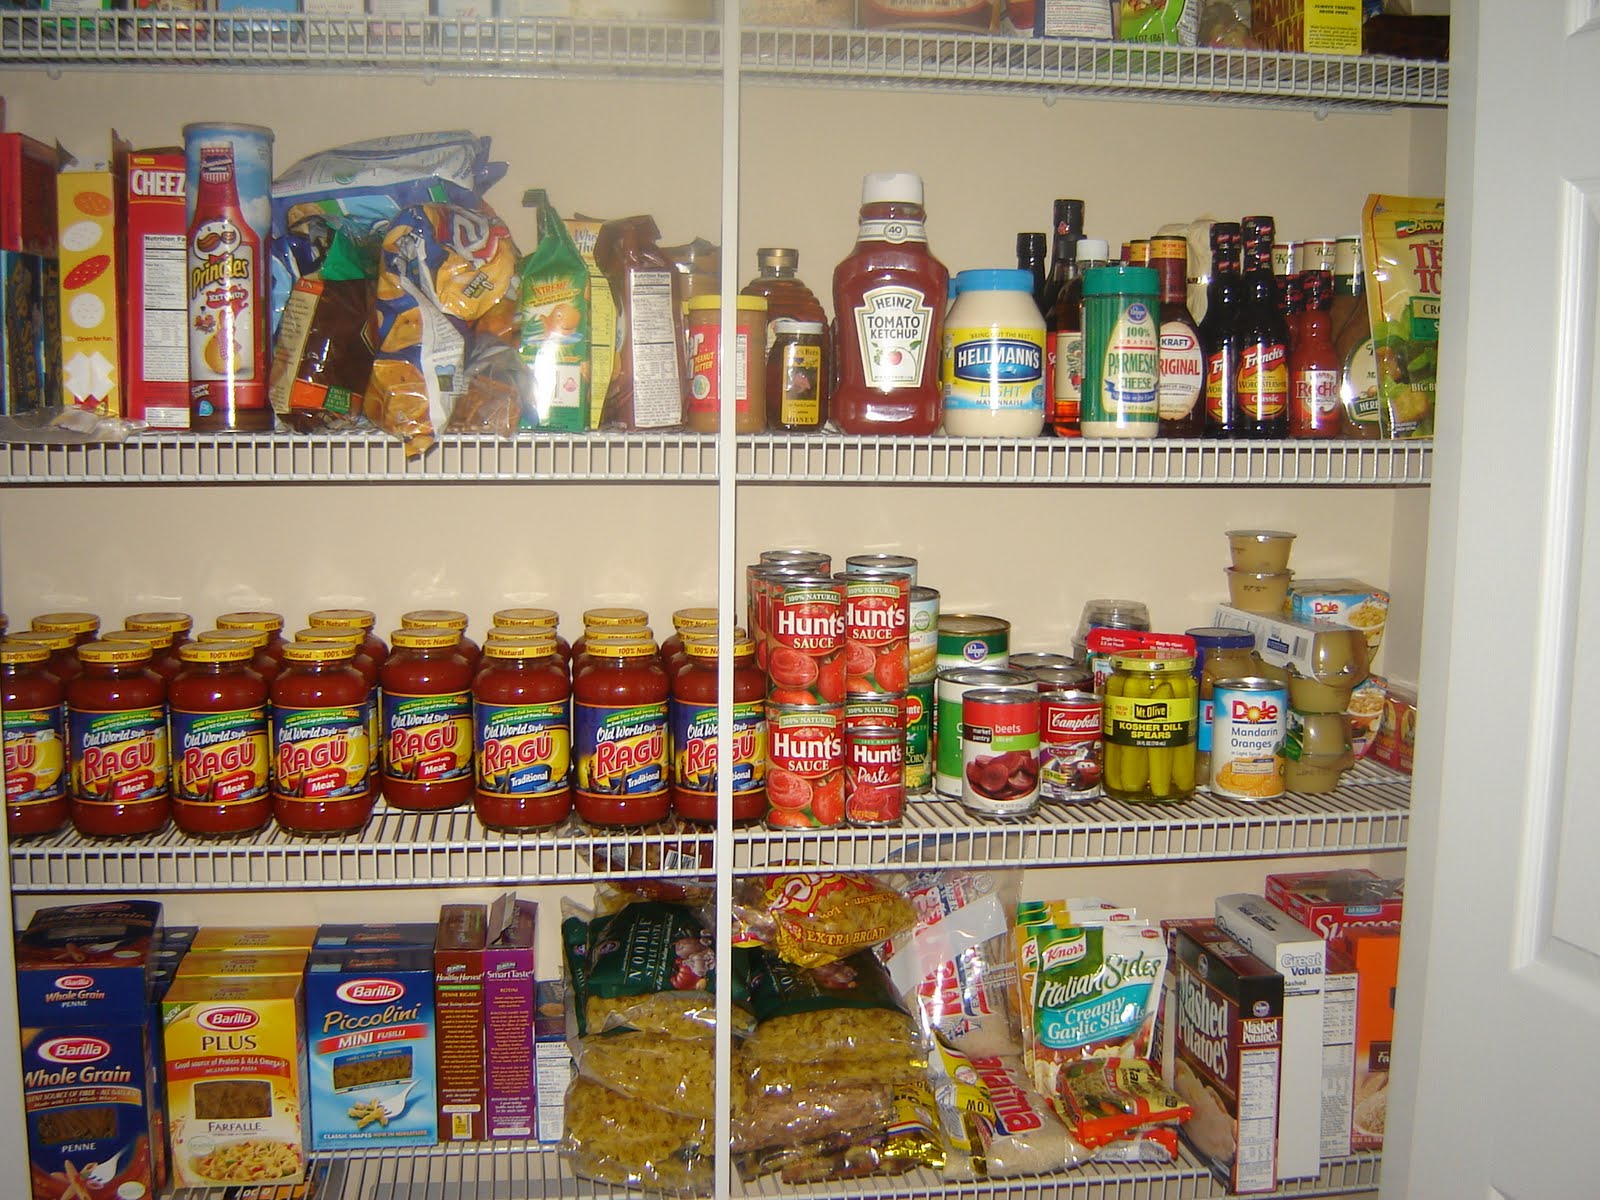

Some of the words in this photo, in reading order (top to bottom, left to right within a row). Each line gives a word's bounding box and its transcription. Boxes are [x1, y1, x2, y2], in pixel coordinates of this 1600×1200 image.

[888, 226, 902, 234] 40
[875, 297, 913, 310] HEINZ
[867, 316, 920, 329] TOMATO
[870, 329, 918, 339] KETCHUP
[1127, 327, 1150, 337] 100%
[958, 347, 1039, 369] HELLMANN'S
[1160, 359, 1200, 376] RIGINAL
[808, 592, 838, 601] NATURAL
[1314, 602, 1339, 614] Dole
[778, 610, 845, 637] Hunt's
[853, 629, 892, 640] SAUCE
[793, 637, 834, 649] SAUCE
[112, 652, 128, 660] 100%
[499, 648, 525, 656] Natural
[1136, 706, 1146, 717] Mt.
[1147, 705, 1166, 717] Olive
[1232, 700, 1278, 721] Dole
[392, 714, 406, 728] Old
[407, 713, 434, 727] World
[434, 714, 449, 723] Style
[800, 716, 832, 725] NATURAL
[1119, 722, 1160, 731] KOSHER
[279, 728, 292, 742] Old
[293, 727, 321, 740] World
[321, 727, 338, 737] Style
[484, 724, 498, 739] Old
[500, 723, 528, 737] World
[528, 724, 544, 734] Style
[597, 727, 614, 742] Old
[616, 723, 644, 738] World
[644, 724, 656, 732] Style
[687, 724, 703, 739] Old
[995, 724, 1020, 733] beets
[1232, 727, 1278, 737] Mandarin
[84, 732, 101, 748] Old
[102, 729, 130, 744] World
[130, 729, 146, 738] Style
[184, 732, 201, 748] Old
[202, 730, 230, 744] World
[230, 729, 247, 739] Style
[1231, 738, 1272, 750] Oranges
[774, 733, 842, 760] Hunt's
[854, 744, 902, 763] Hunt's
[425, 762, 447, 775] Meat
[788, 759, 830, 772] SAUCE
[511, 771, 548, 786] Traditional
[627, 770, 659, 788] Traditional
[857, 766, 890, 783] Paste
[122, 782, 145, 795] Meat
[222, 782, 246, 796] Meat
[312, 779, 336, 792] Meat
[807, 930, 849, 946] EXTRA
[852, 928, 885, 943] BROAD
[1046, 944, 1085, 964] Knorr
[1281, 952, 1322, 968] Great
[436, 974, 458, 983] Healthy
[460, 973, 482, 981] Harvest
[487, 970, 510, 979] Smart
[510, 970, 529, 978] Taste
[1038, 964, 1105, 1008] Italian
[1105, 950, 1161, 989] Sides
[45, 990, 77, 1002] Whole
[78, 990, 105, 999] Grain
[351, 984, 398, 998] Barilla
[62, 1000, 88, 1008] PENNE
[1179, 964, 1228, 1038] Mashed
[322, 1002, 421, 1033] Piccolini
[1065, 997, 1126, 1025] Creamy
[212, 1013, 252, 1024] Barilla
[1048, 1020, 1098, 1040] Garlic
[1243, 1019, 1278, 1033] Mashed
[202, 1035, 257, 1051] PLUS
[338, 1031, 373, 1050] MINI
[377, 1030, 406, 1040] FUSILLI
[1178, 1001, 1228, 1080] Potatoes
[1243, 1032, 1278, 1044] Potatoes
[55, 1044, 102, 1056] Barilla
[25, 1067, 77, 1088] Whole
[80, 1065, 131, 1082] Grain
[208, 1121, 262, 1132] FARFALLE
[61, 1142, 96, 1152] PENNE
